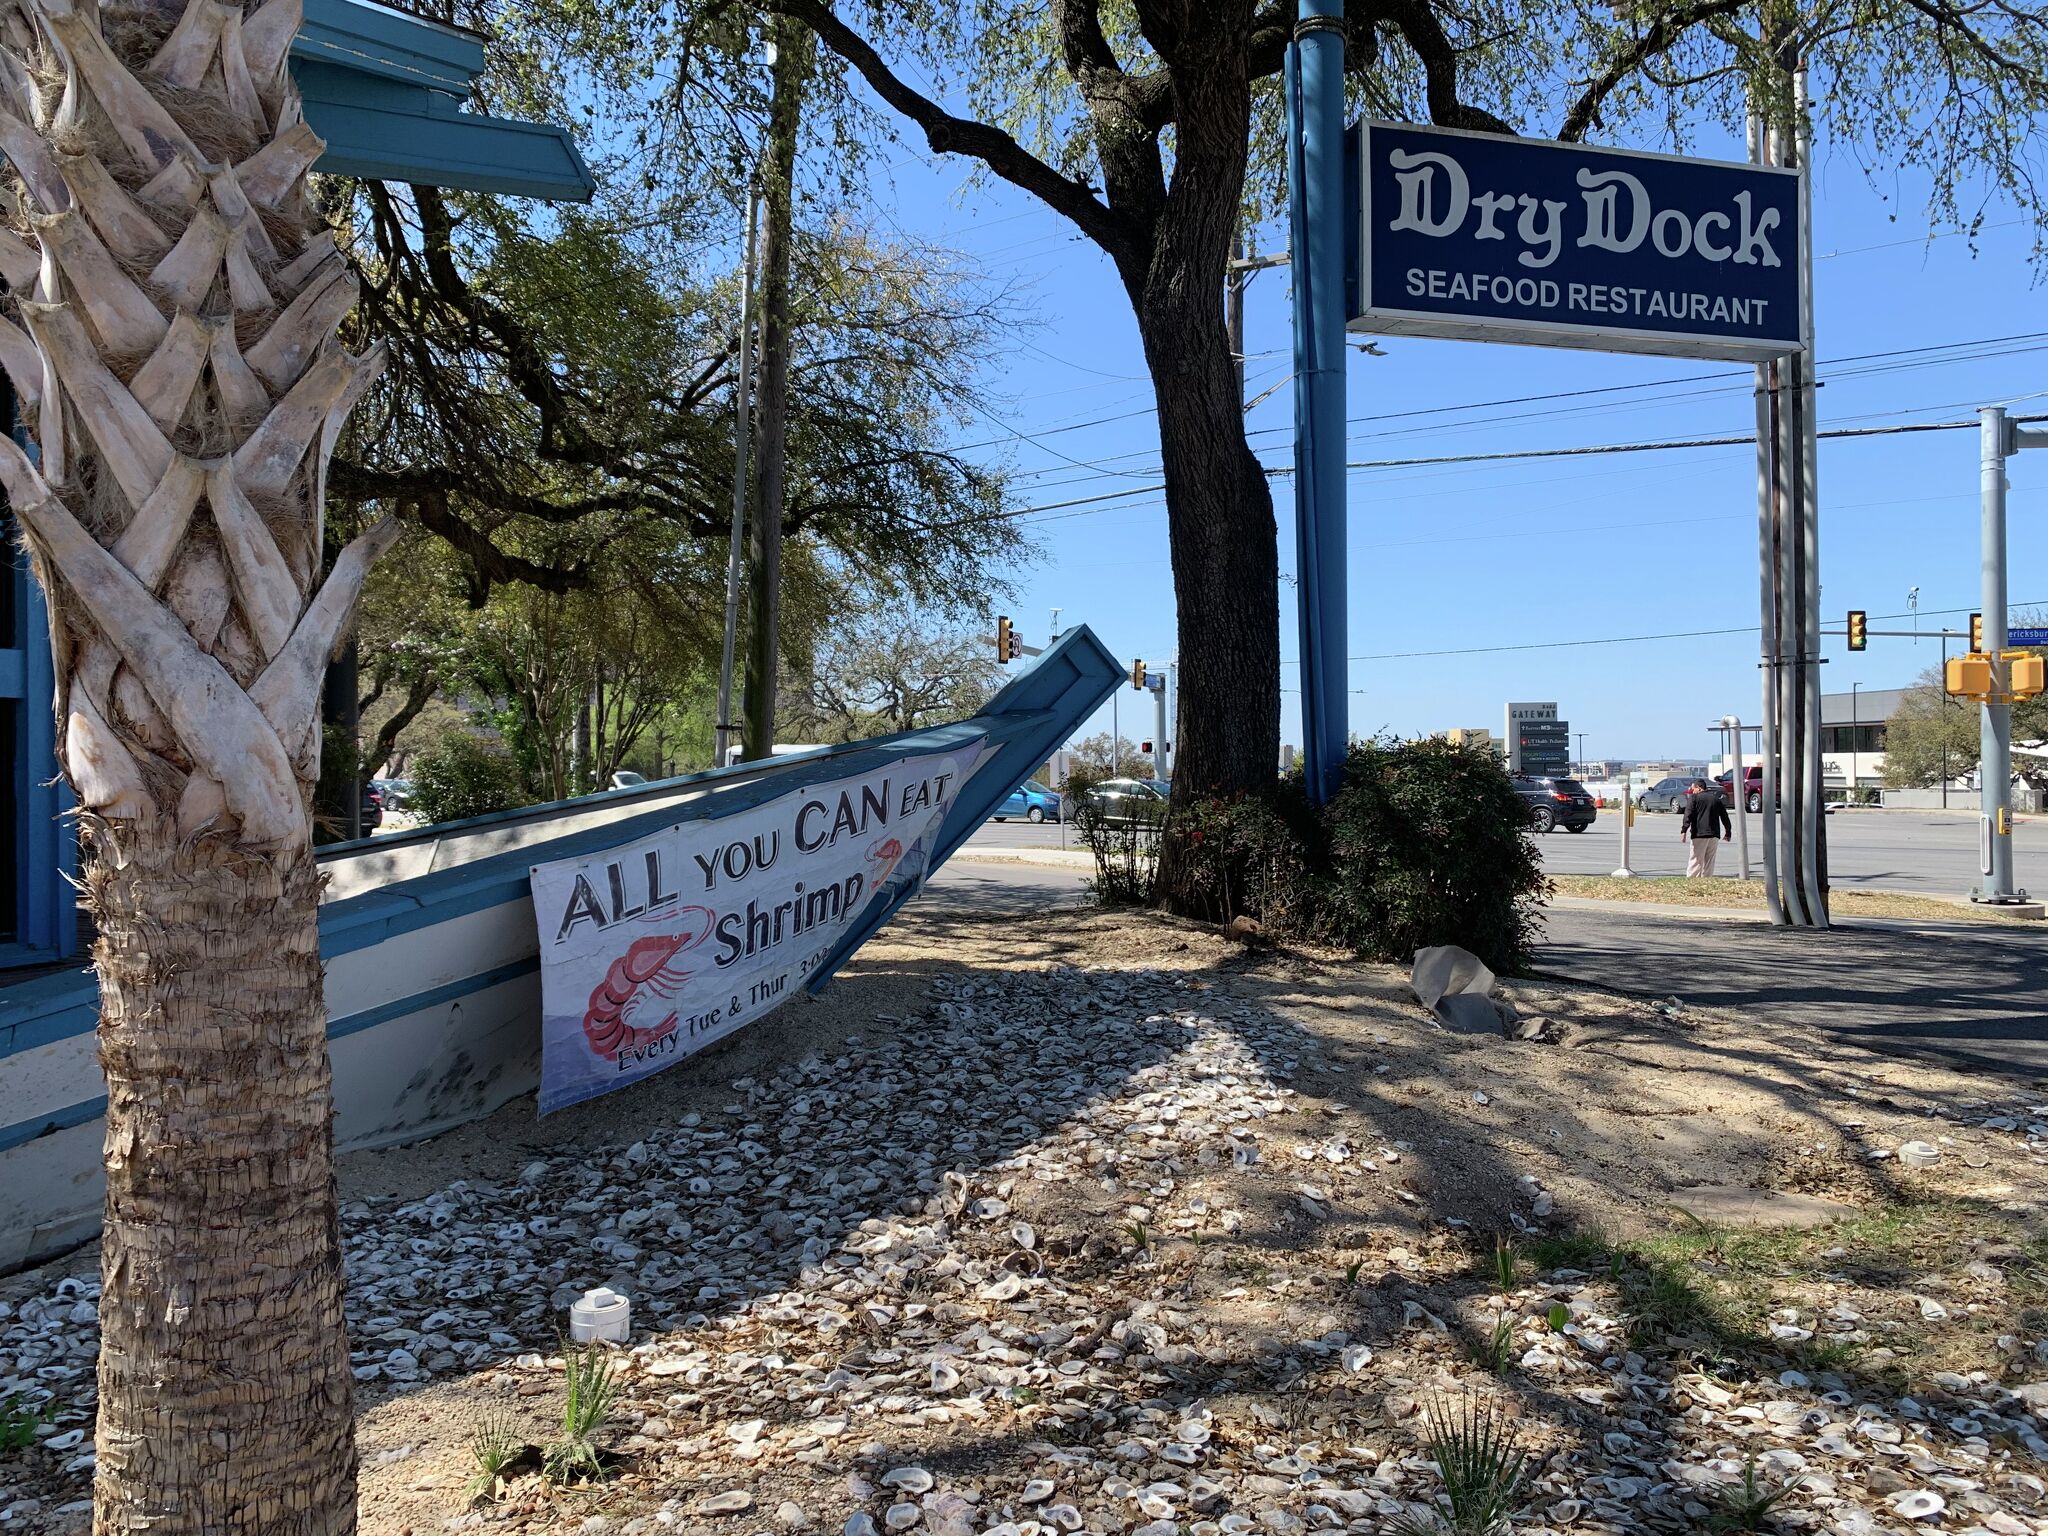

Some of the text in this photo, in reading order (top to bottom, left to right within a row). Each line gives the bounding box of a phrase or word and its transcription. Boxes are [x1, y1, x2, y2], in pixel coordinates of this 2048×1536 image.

[1389, 147, 1781, 268] Dry Dock
[1406, 268, 1768, 326] SEAFOOD RESTAURANT
[1512, 710, 1556, 718] GATEWAY
[555, 771, 953, 945] ALL YOU CAN EAT
[713, 870, 865, 969] Shrimp
[616, 1029, 680, 1073] Every
[685, 1008, 721, 1038] Tue
[728, 995, 742, 1017] &
[748, 974, 788, 1006] Thur
